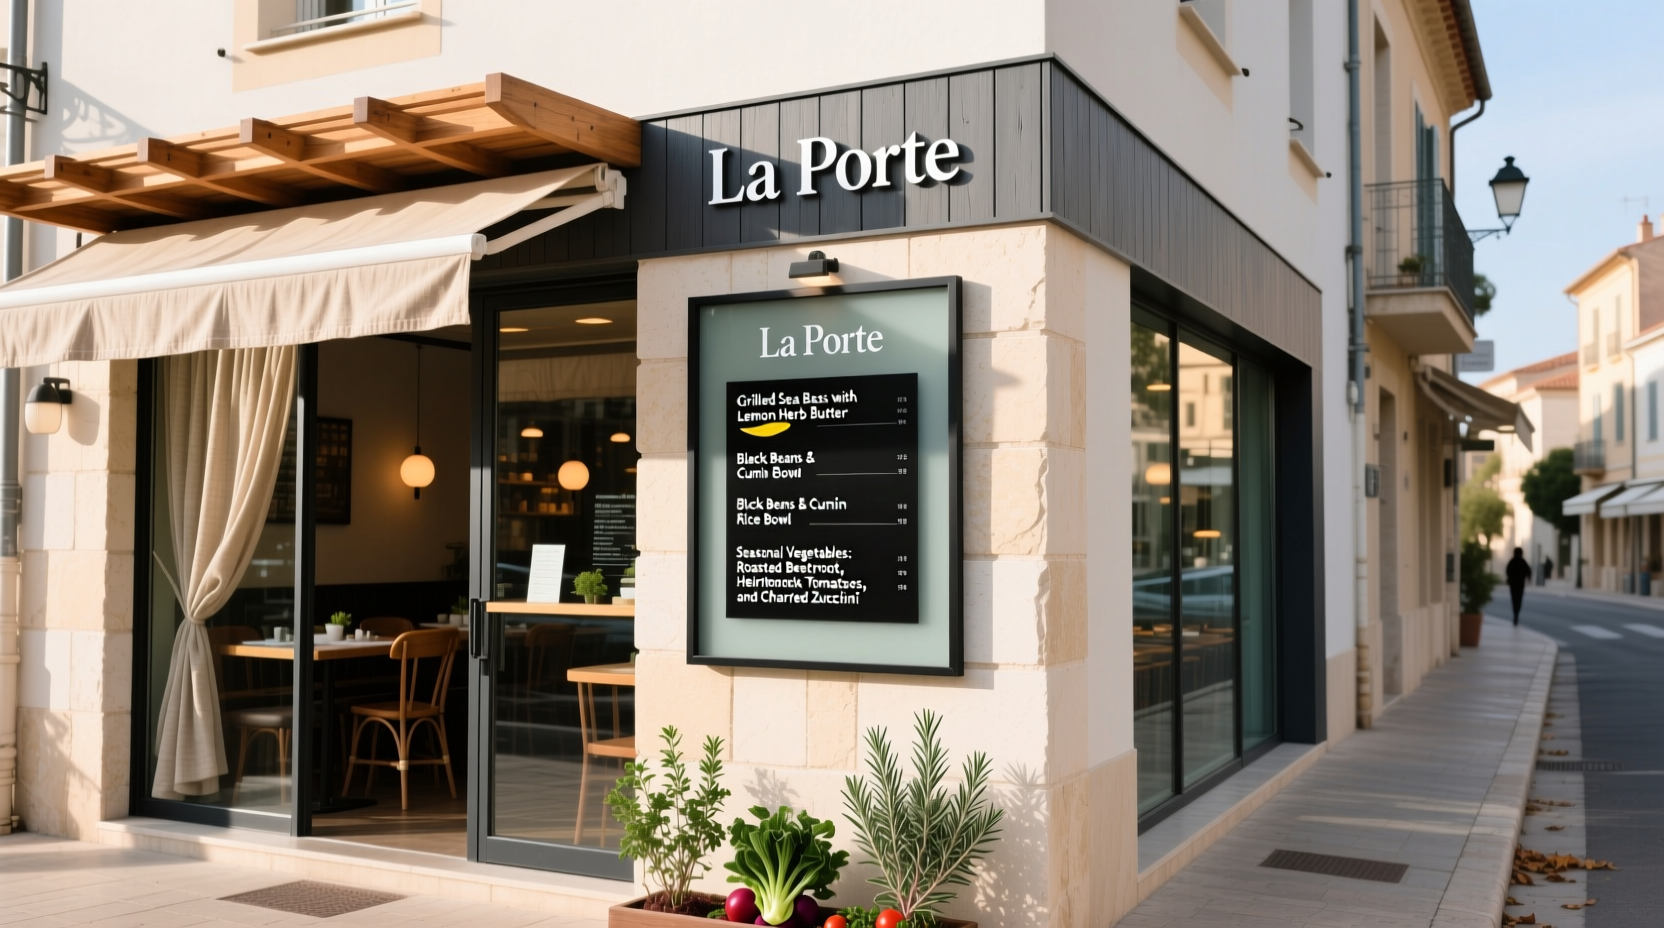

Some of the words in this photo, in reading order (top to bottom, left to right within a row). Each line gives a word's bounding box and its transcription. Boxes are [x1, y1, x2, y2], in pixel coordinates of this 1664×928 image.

[708, 147, 781, 205] La
[796, 131, 960, 196] Porte
[759, 327, 797, 358] La
[803, 324, 883, 356] Porte
[778, 391, 801, 406] Sea
[830, 388, 858, 404] with
[737, 410, 777, 423] Lemon
[778, 406, 808, 422] Herb
[763, 512, 792, 526] Bowl
[736, 590, 758, 603] and
